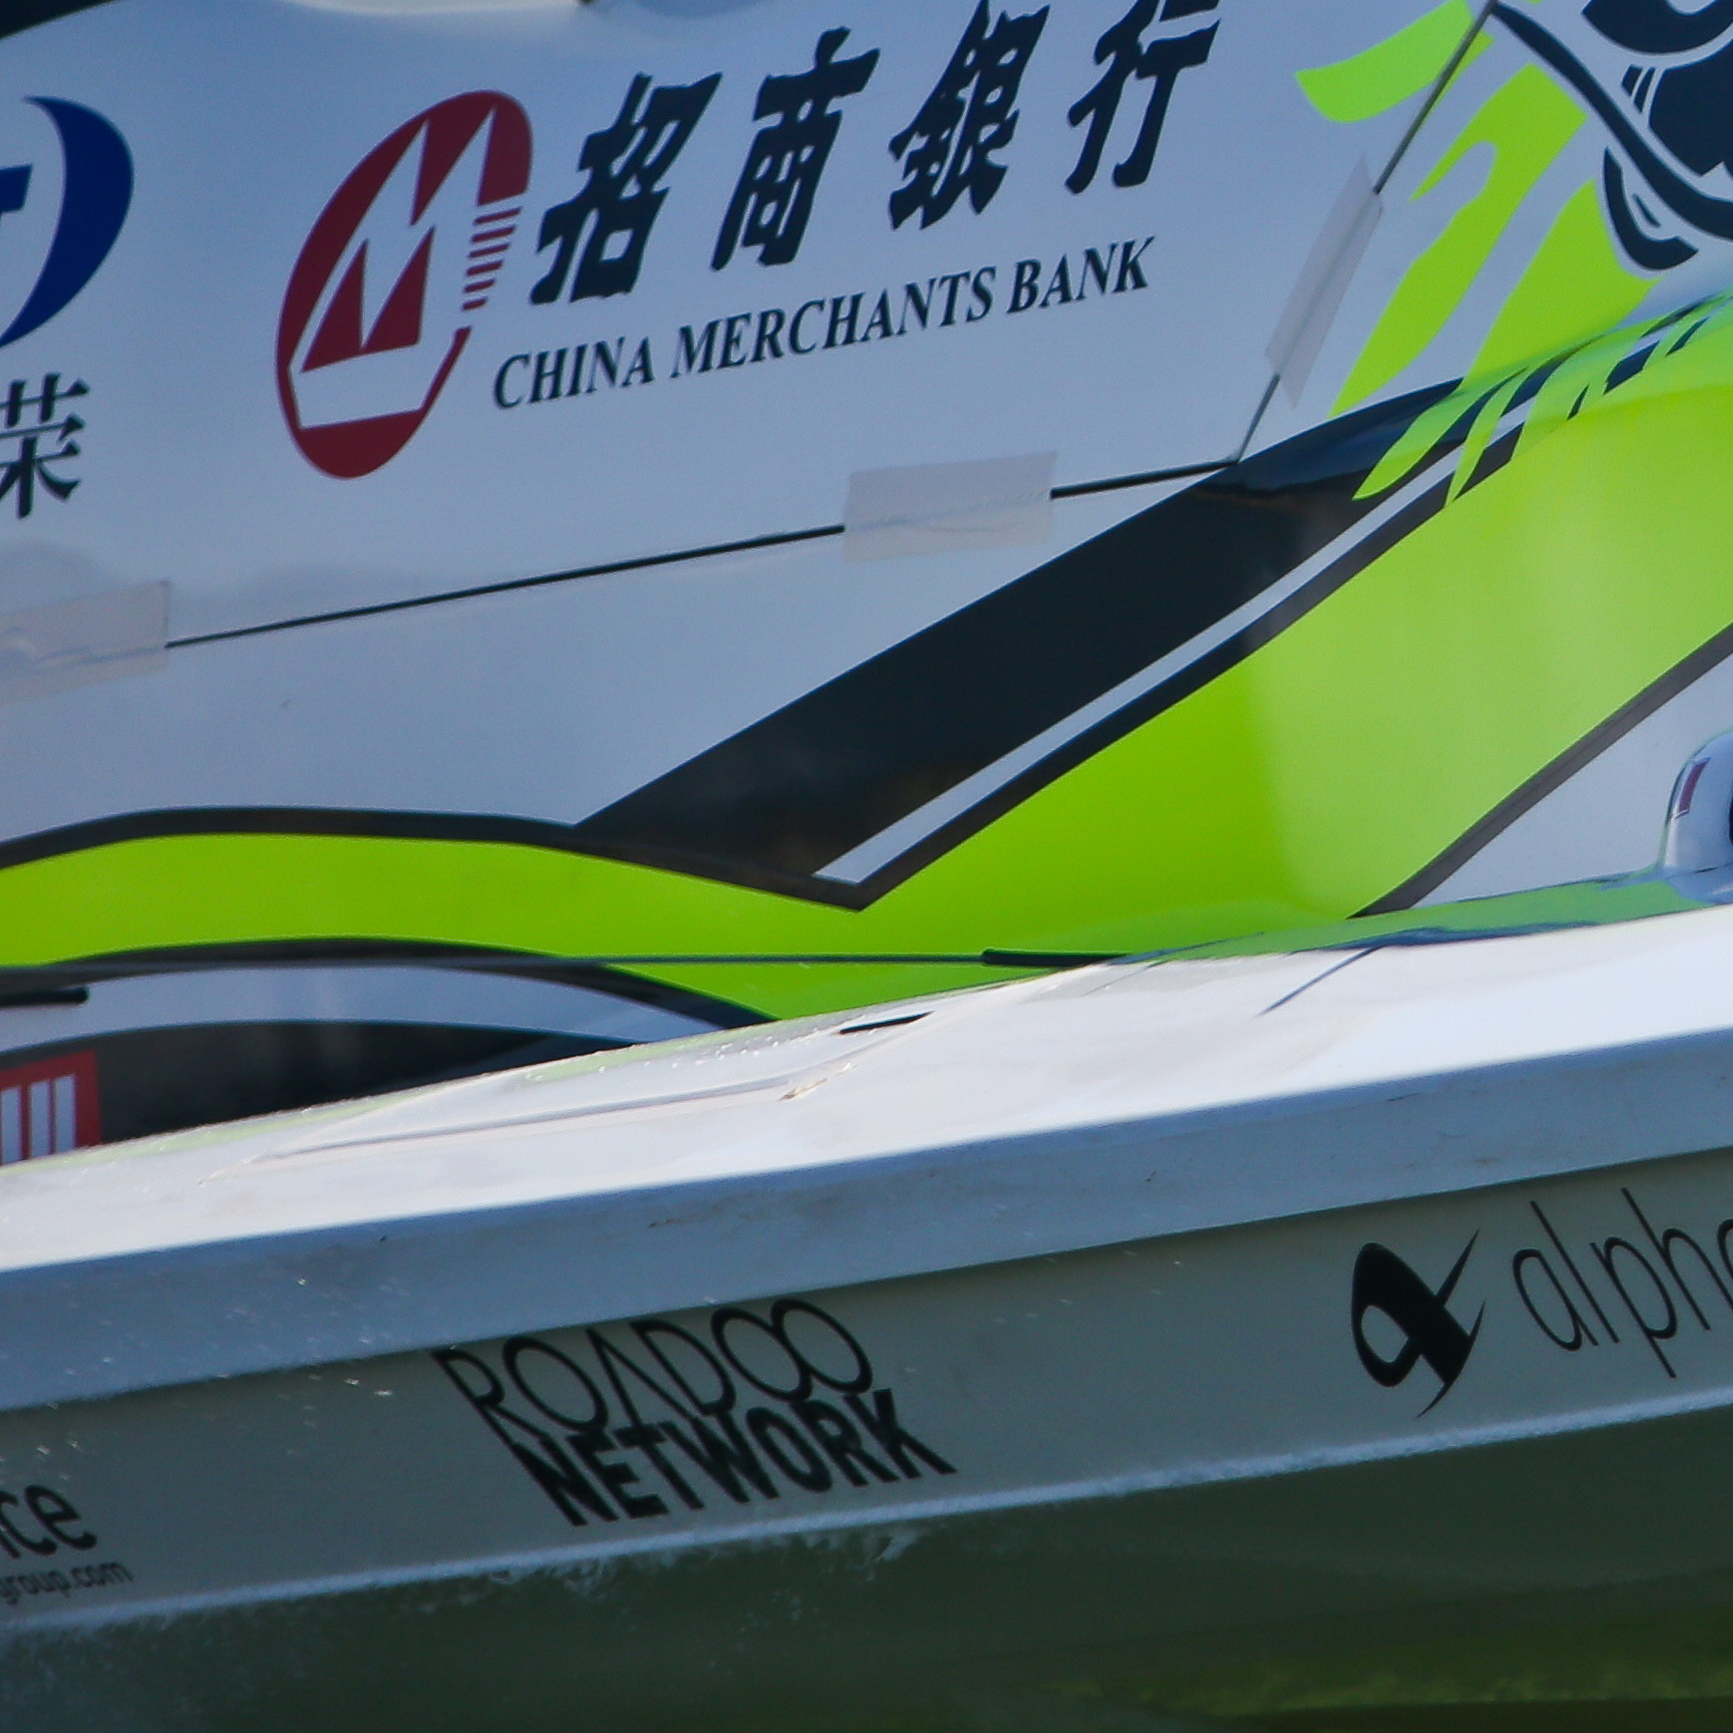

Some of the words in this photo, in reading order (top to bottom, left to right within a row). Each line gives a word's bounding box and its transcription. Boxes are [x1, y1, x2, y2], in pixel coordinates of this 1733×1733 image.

[492, 335, 655, 409] CHINA
[669, 267, 996, 378] MERCHANTS
[1006, 236, 1155, 314] BANK
[508, 1388, 956, 1527] NETWORK
